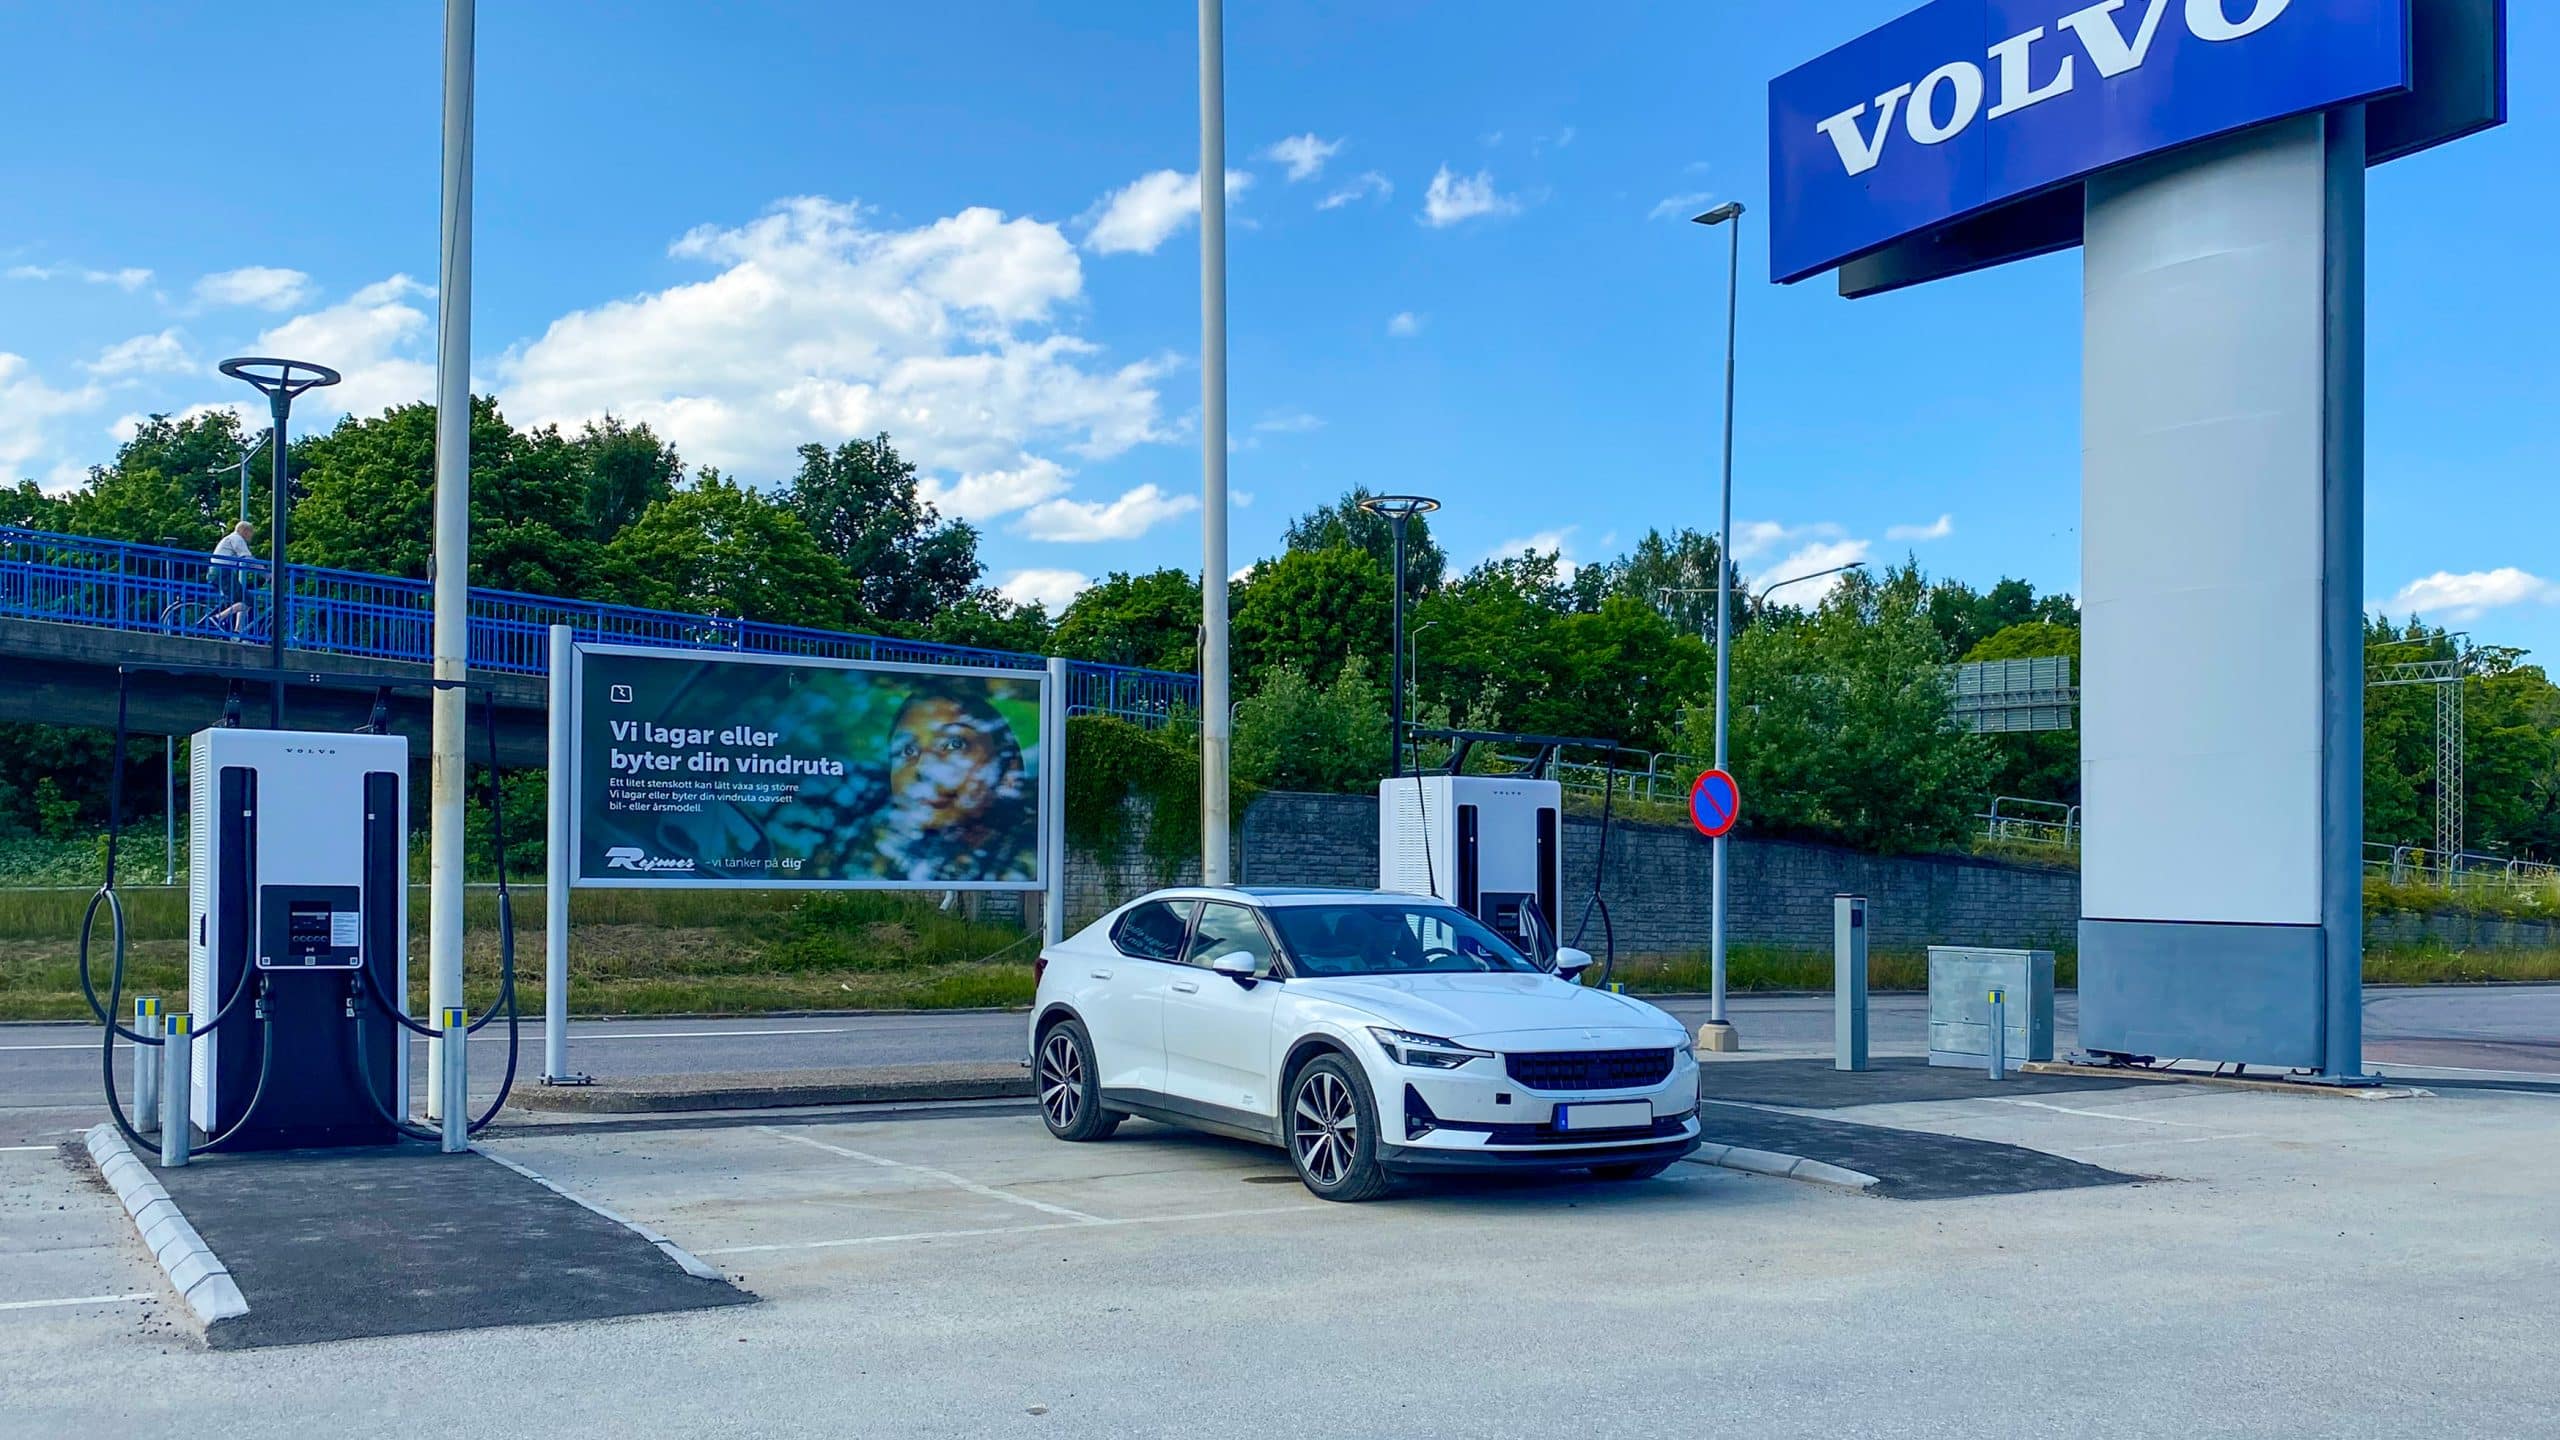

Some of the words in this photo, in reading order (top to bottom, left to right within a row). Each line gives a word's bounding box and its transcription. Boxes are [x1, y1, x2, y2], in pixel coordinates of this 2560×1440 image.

[609, 720, 638, 742] Vi
[645, 722, 715, 749] lagar
[719, 725, 779, 747] eller
[611, 748, 682, 774] byter
[687, 752, 730, 772] din
[735, 753, 844, 776] vindruta
[609, 778, 624, 788] Ett
[626, 778, 646, 789] litet
[647, 779, 692, 790] stenskott
[694, 780, 713, 791] kan
[714, 781, 730, 791] lätt
[755, 782, 769, 793] sig
[609, 789, 620, 799] Vi
[621, 789, 647, 801] lagar
[648, 791, 670, 801] eller
[672, 791, 698, 803] byter
[699, 792, 715, 802] din
[716, 792, 757, 802] vindruta
[758, 794, 793, 804] oavsett
[609, 800, 627, 811] bil-
[628, 801, 651, 812] eller
[725, 857, 761, 868] tänker
[764, 857, 779, 871] på
